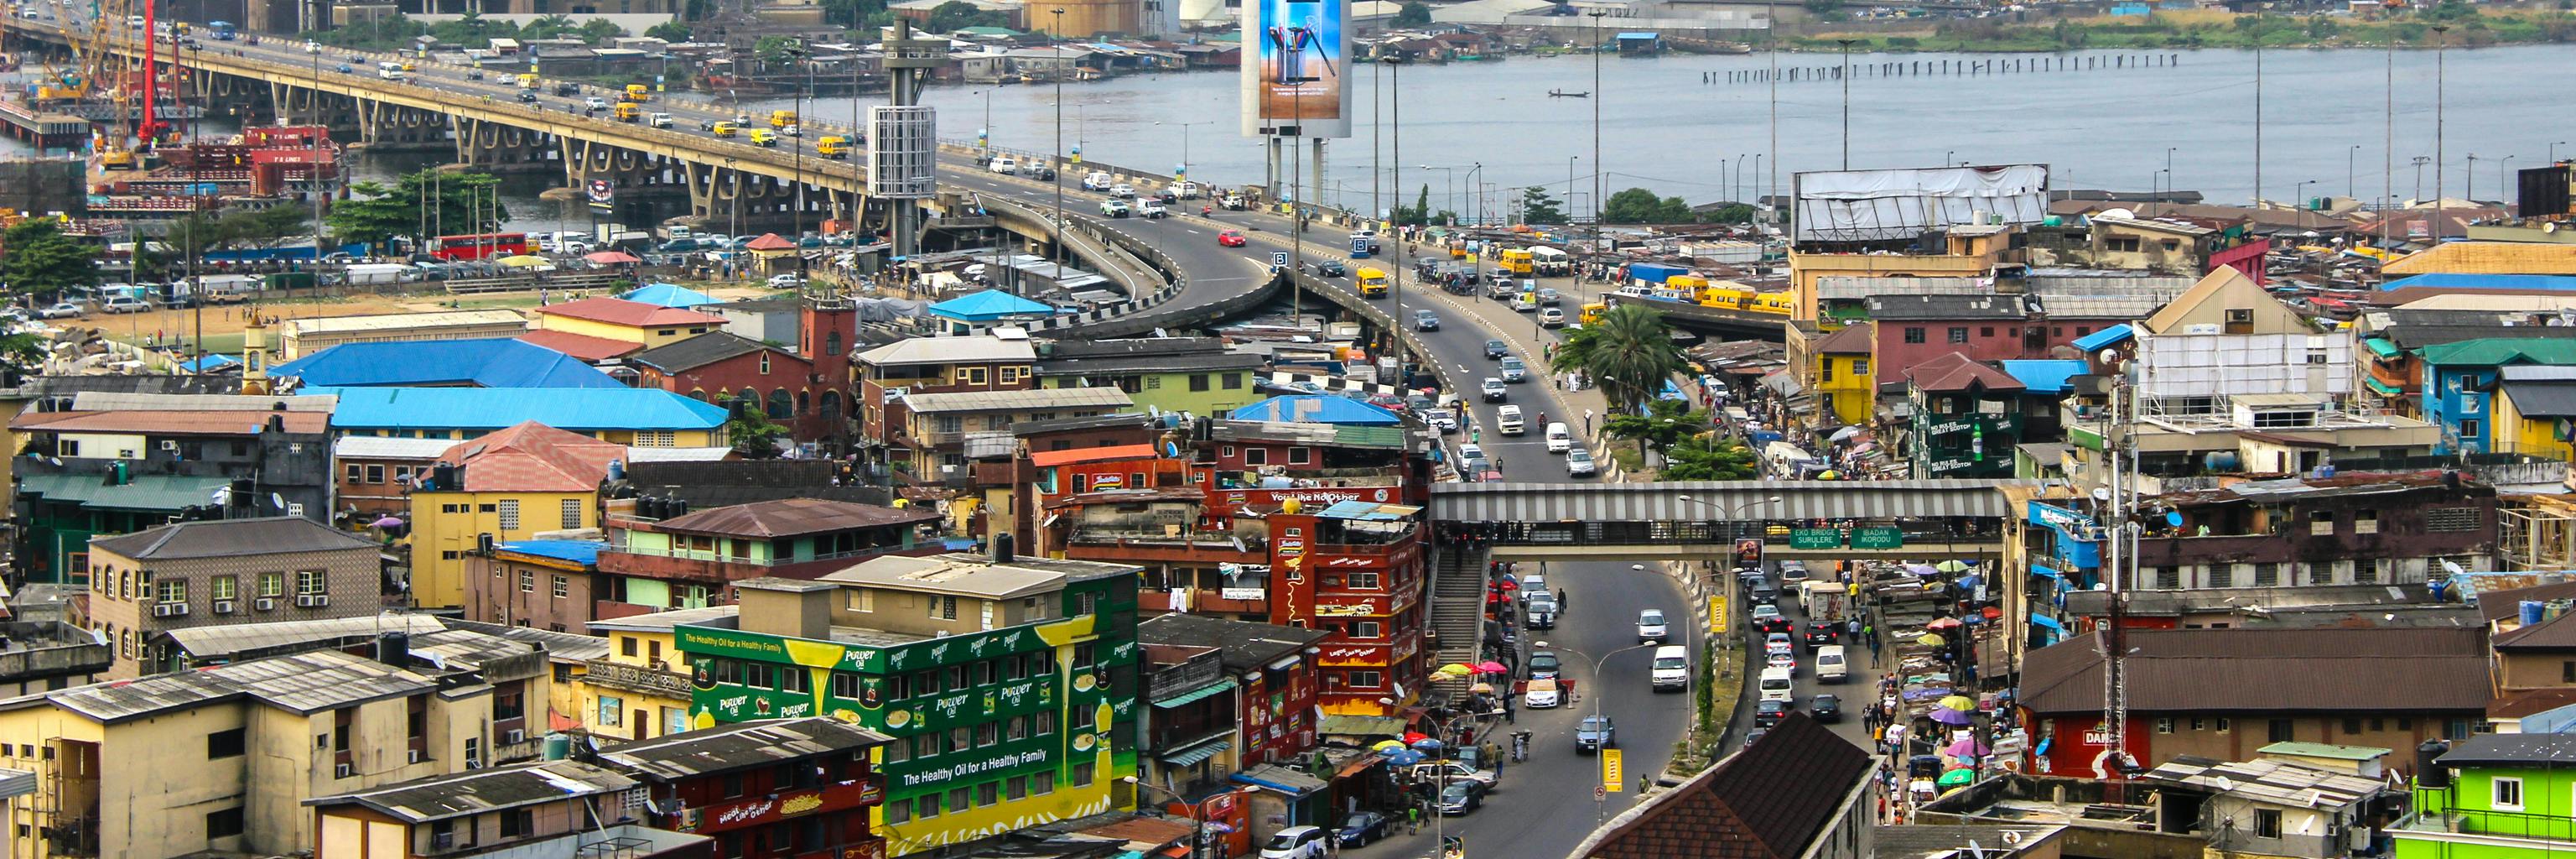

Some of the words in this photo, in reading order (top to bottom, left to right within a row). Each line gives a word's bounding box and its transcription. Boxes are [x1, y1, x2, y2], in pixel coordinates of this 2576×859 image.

[1358, 241, 1364, 249] B
[1277, 254, 1284, 263] B
[1950, 424, 1971, 432] SCOTCH
[1951, 461, 1971, 470] SCOTCH
[1328, 492, 1359, 501] Other
[685, 634, 695, 643] The
[697, 635, 718, 647] Healthy
[741, 640, 762, 651] Healthy
[763, 643, 782, 653] Family
[845, 650, 875, 661] Power
[855, 659, 865, 668] Oil
[1000, 683, 1032, 700] Power
[719, 695, 747, 711] Power
[936, 694, 969, 711] Power
[1011, 695, 1021, 704] Oil
[781, 702, 809, 718] Power
[948, 706, 956, 716] Oil
[903, 773, 920, 786] The
[922, 768, 953, 784] Healthy
[955, 763, 967, 777] Oil
[969, 762, 980, 773] for
[982, 762, 987, 770] a
[989, 753, 1020, 770] Healthy
[1021, 748, 1046, 763] Family
[750, 801, 772, 819] Other
